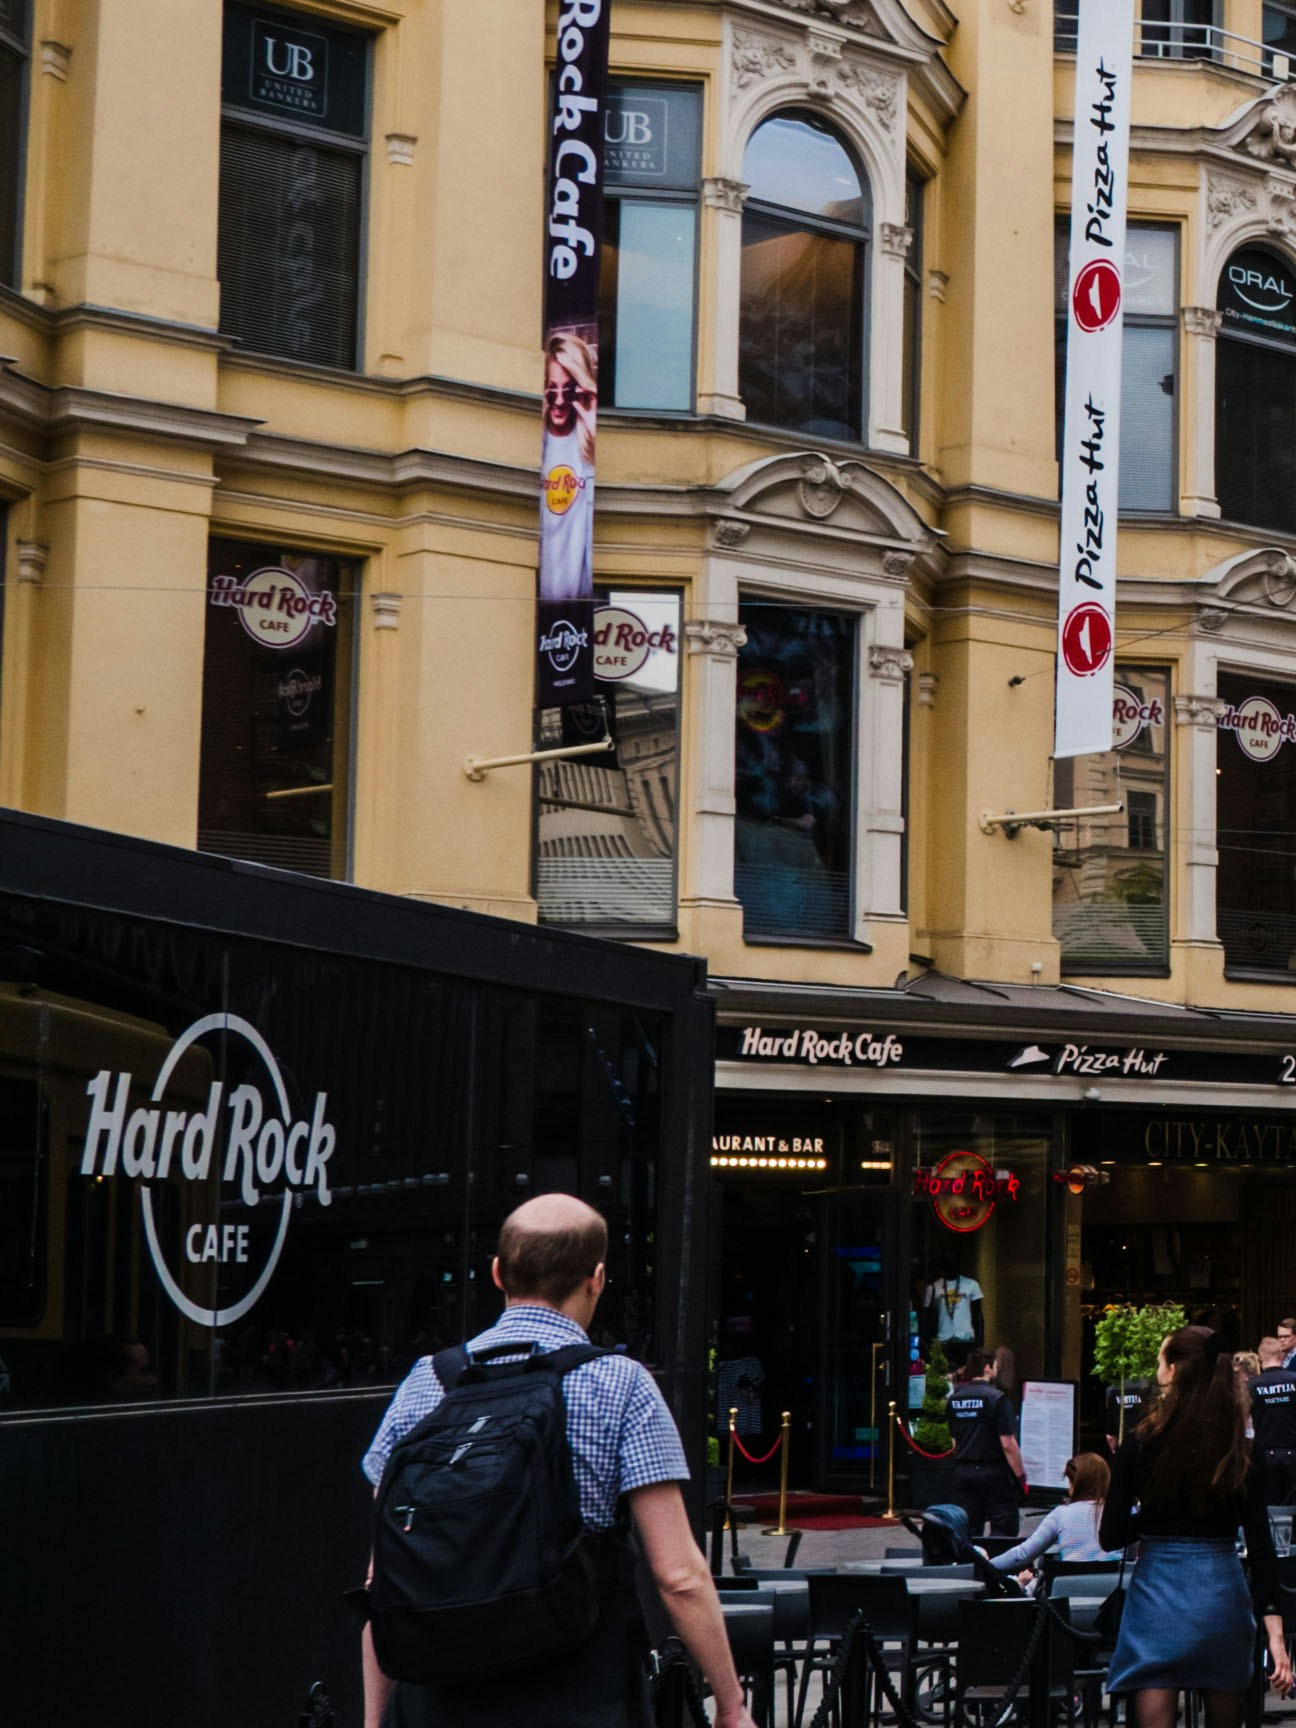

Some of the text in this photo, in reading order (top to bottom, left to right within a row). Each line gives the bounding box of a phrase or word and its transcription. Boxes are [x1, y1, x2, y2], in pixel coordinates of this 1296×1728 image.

[264, 36, 314, 81] UB
[604, 110, 652, 144] UB
[605, 157, 656, 170] ANKERS
[608, 148, 651, 162] NITED
[1085, 55, 1117, 248] Pizza Hut
[549, 139, 598, 280] Cafe
[1229, 265, 1294, 298] ORAL
[1075, 391, 1105, 590] Pizza Hut
[211, 575, 337, 626] Hard Rock
[259, 619, 290, 633] CAFE
[614, 623, 677, 653] Rock
[560, 628, 589, 652] Rock
[596, 656, 628, 666] CAFE
[1112, 698, 1162, 725] Rock
[1218, 705, 1260, 730] Hard
[1249, 739, 1269, 750] CAFE
[742, 1027, 903, 1066] Hard Rock Cafe
[1057, 1043, 1168, 1074] Pizza Hut
[81, 1070, 336, 1206] Hard Rock
[711, 1135, 825, 1153] AURANT & BAR
[915, 1169, 965, 1196] Hard
[185, 1223, 250, 1264] CAFE
[1115, 1393, 1142, 1405] VRTIJA
[1256, 1382, 1296, 1396] VARTIJA
[951, 1398, 984, 1410] VARTIJA
